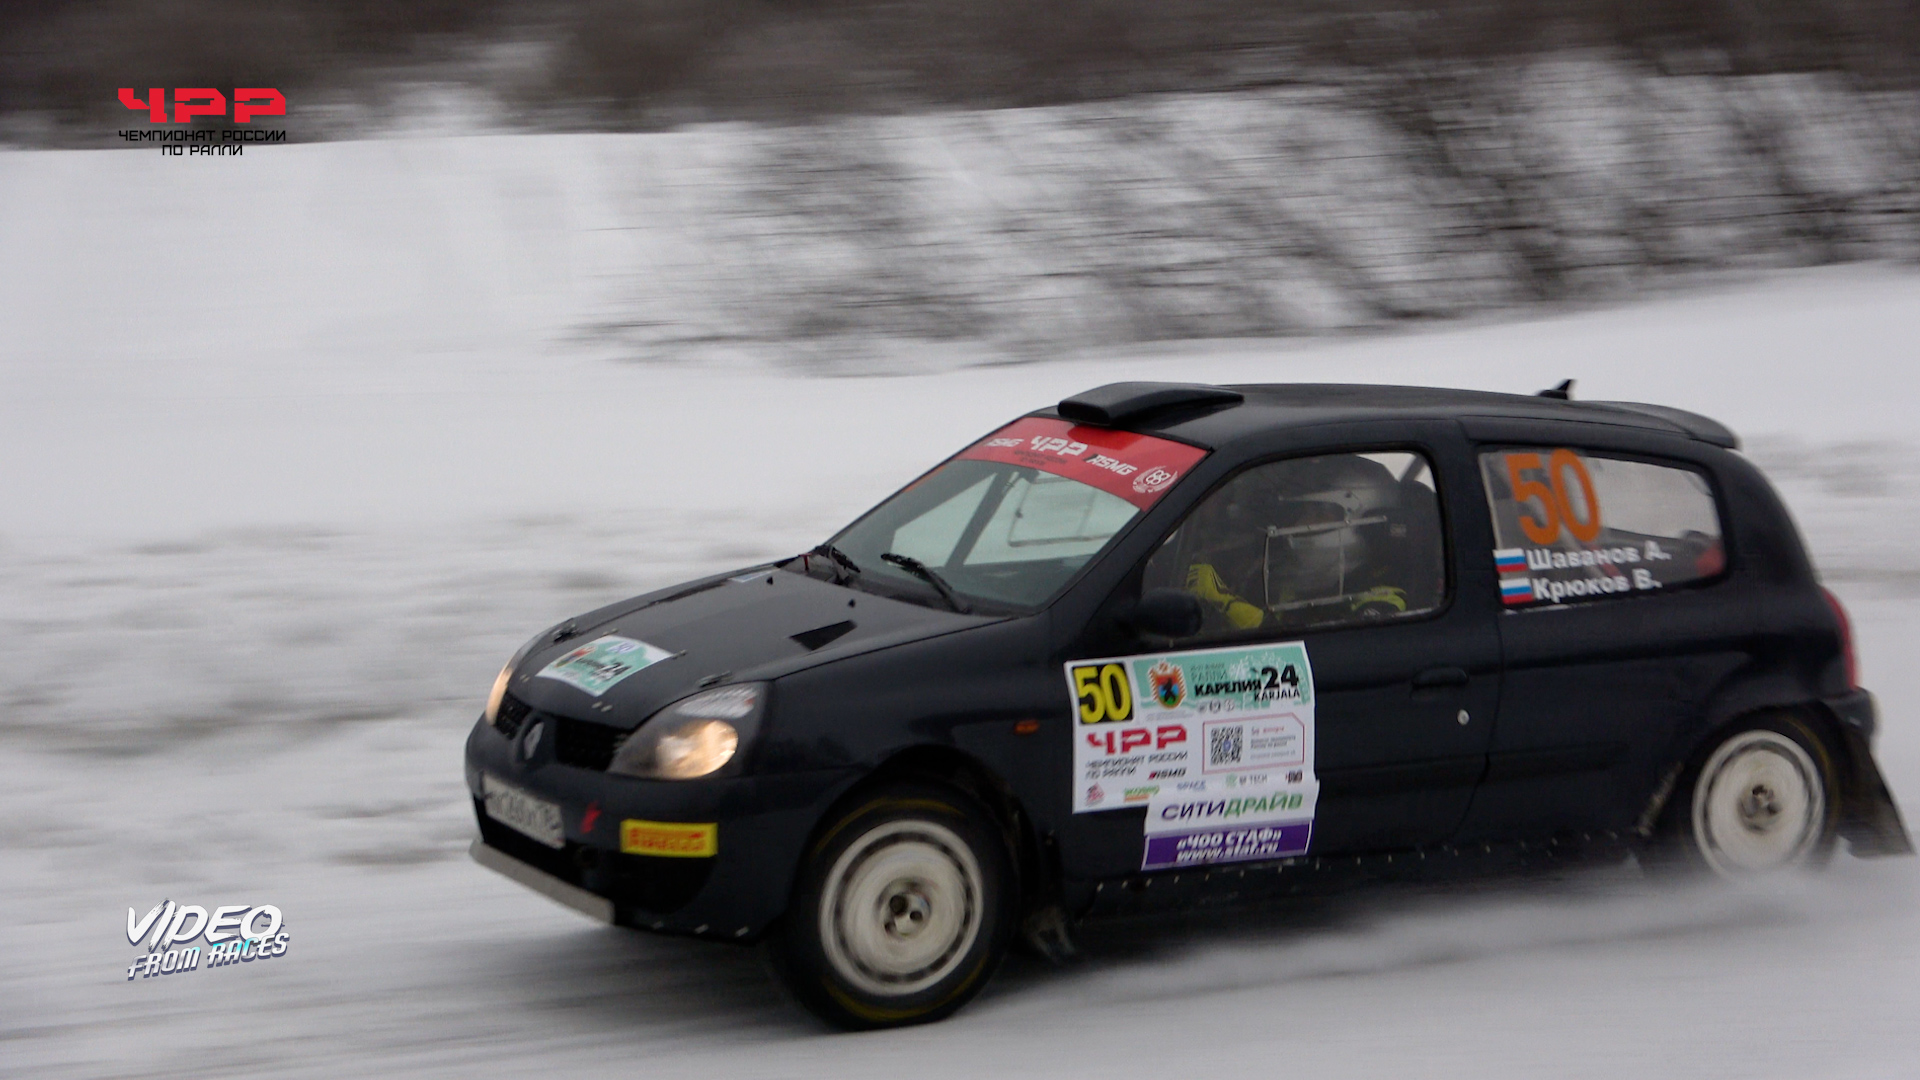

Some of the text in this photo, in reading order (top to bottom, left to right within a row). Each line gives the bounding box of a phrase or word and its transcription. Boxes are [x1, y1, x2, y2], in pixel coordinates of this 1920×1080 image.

[1031, 435, 1089, 456] ЧРР
[1506, 448, 1601, 545] 50
[1526, 540, 1672, 570] Шаванов А.
[1531, 575, 1631, 603] Крюков
[1073, 663, 1133, 723] 50
[1194, 679, 1262, 697] КАРЕЛИЯ
[1254, 688, 1300, 702] KARJALA
[1086, 724, 1187, 756] ЧРР
[1148, 750, 1188, 763] РОССИИ
[1161, 791, 1303, 821] СИТИДРАЙВ
